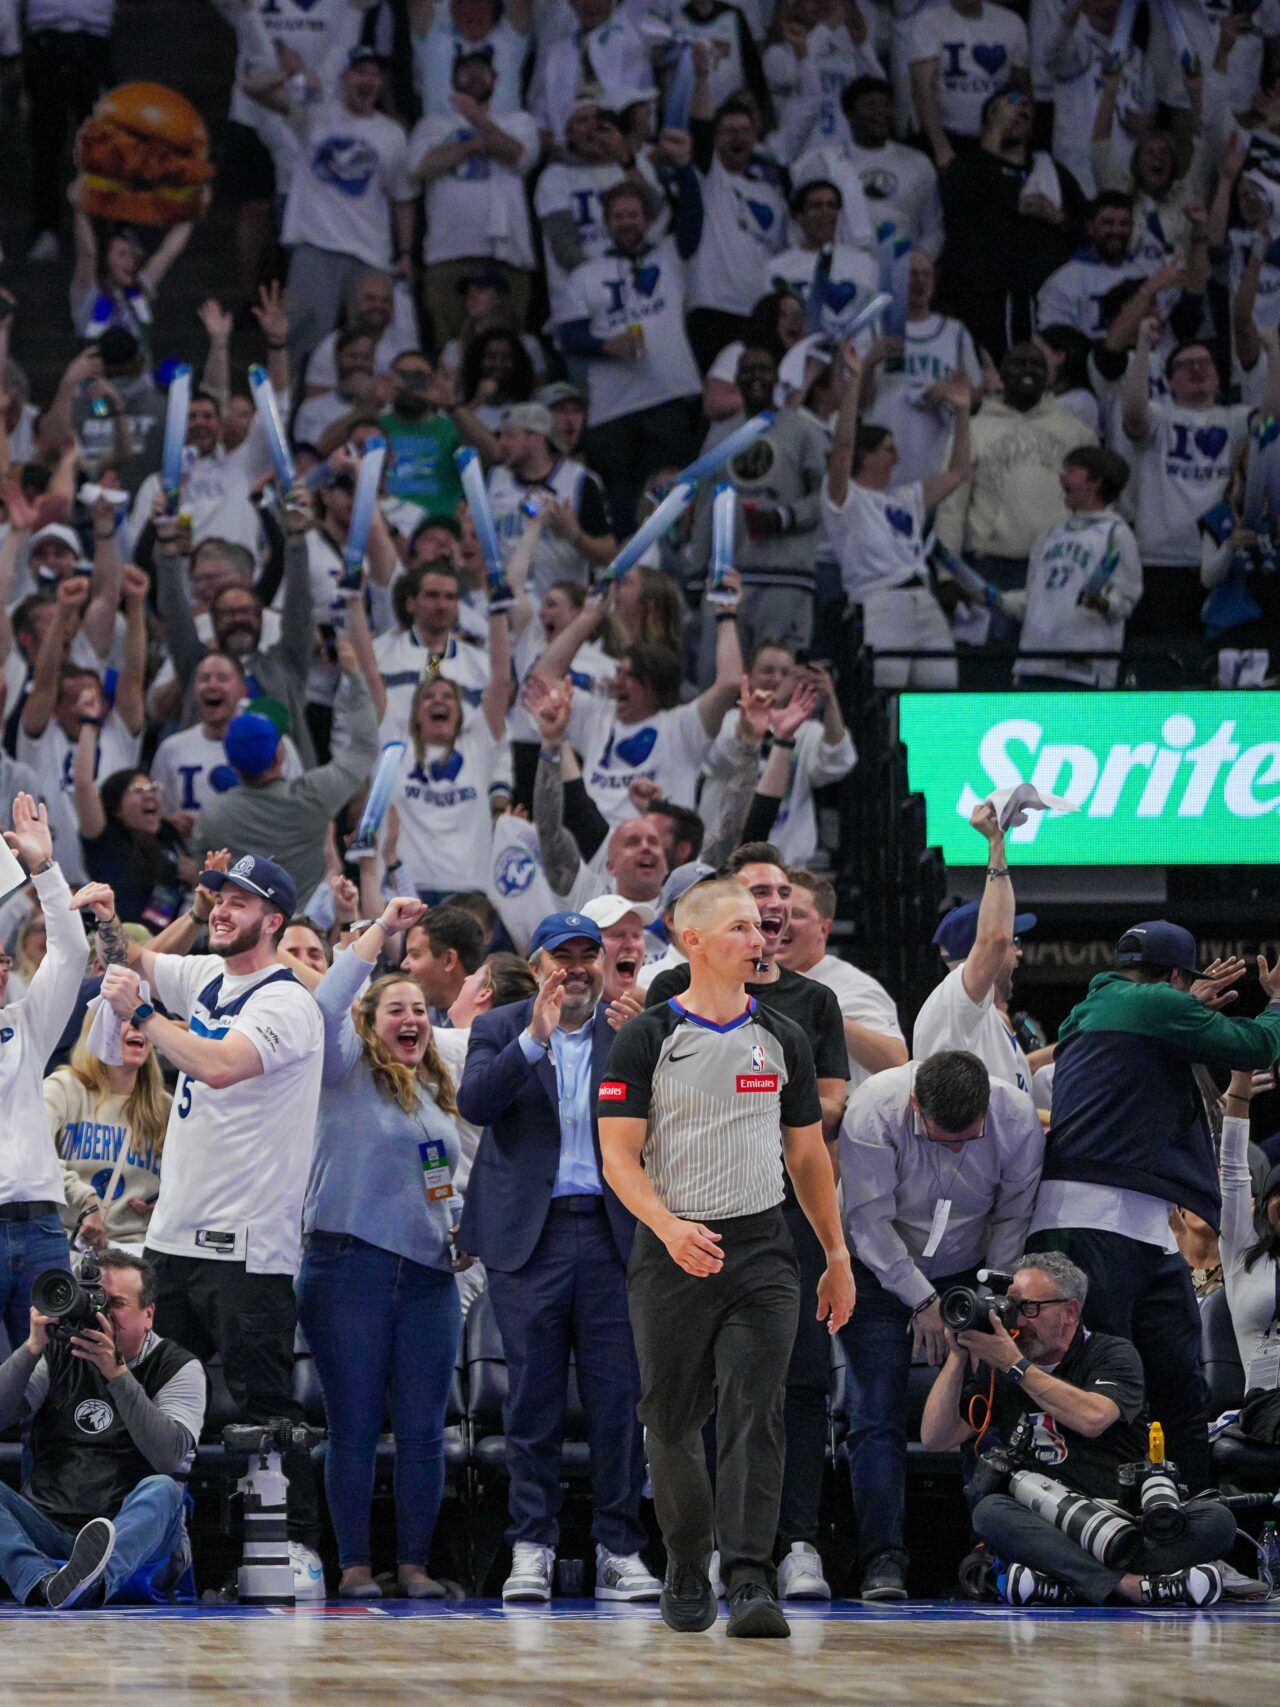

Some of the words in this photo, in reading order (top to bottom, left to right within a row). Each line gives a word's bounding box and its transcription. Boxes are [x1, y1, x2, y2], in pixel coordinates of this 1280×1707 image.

[944, 44, 966, 76] I
[573, 190, 594, 225] I
[604, 279, 625, 314] I
[1170, 424, 1191, 462] I
[178, 766, 202, 810] I
[955, 712, 1280, 845] Sprite
[740, 1077, 775, 1090] Emirates
